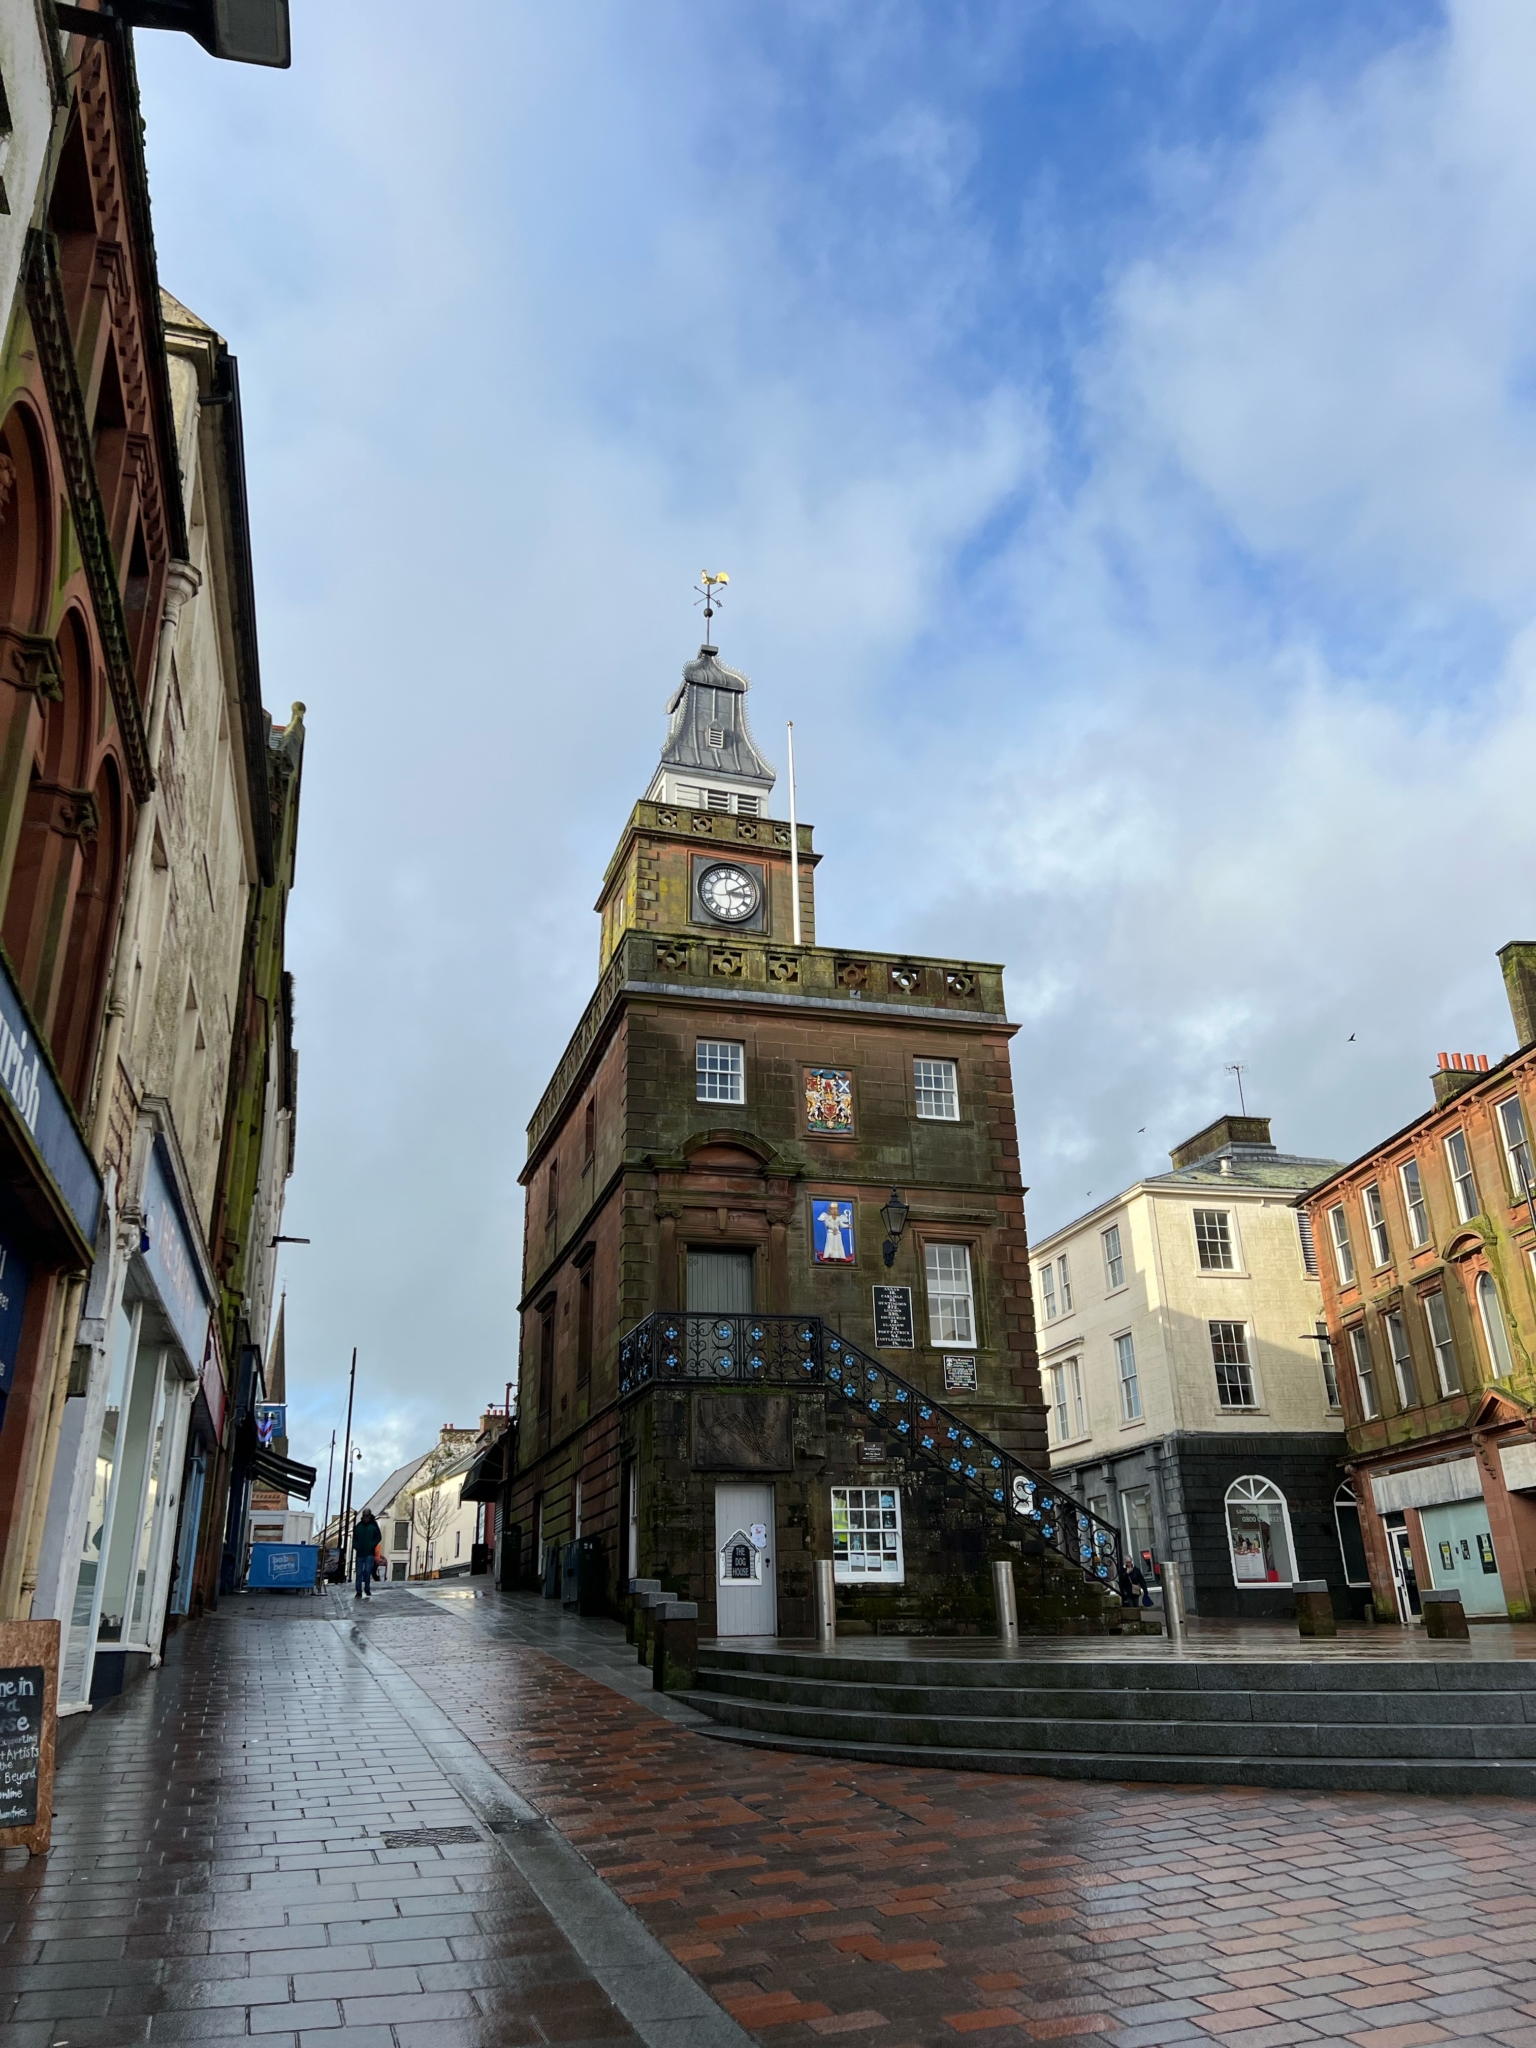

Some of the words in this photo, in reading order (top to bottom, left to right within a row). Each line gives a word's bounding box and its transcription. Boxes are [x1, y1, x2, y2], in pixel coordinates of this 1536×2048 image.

[735, 1547, 746, 1556] THE
[735, 1557, 747, 1567] DOG
[732, 1567, 750, 1577] HOUSE
[17, 1676, 35, 1696] in
[6, 1746, 40, 1761] Artists
[4, 1767, 38, 1785] Beyond
